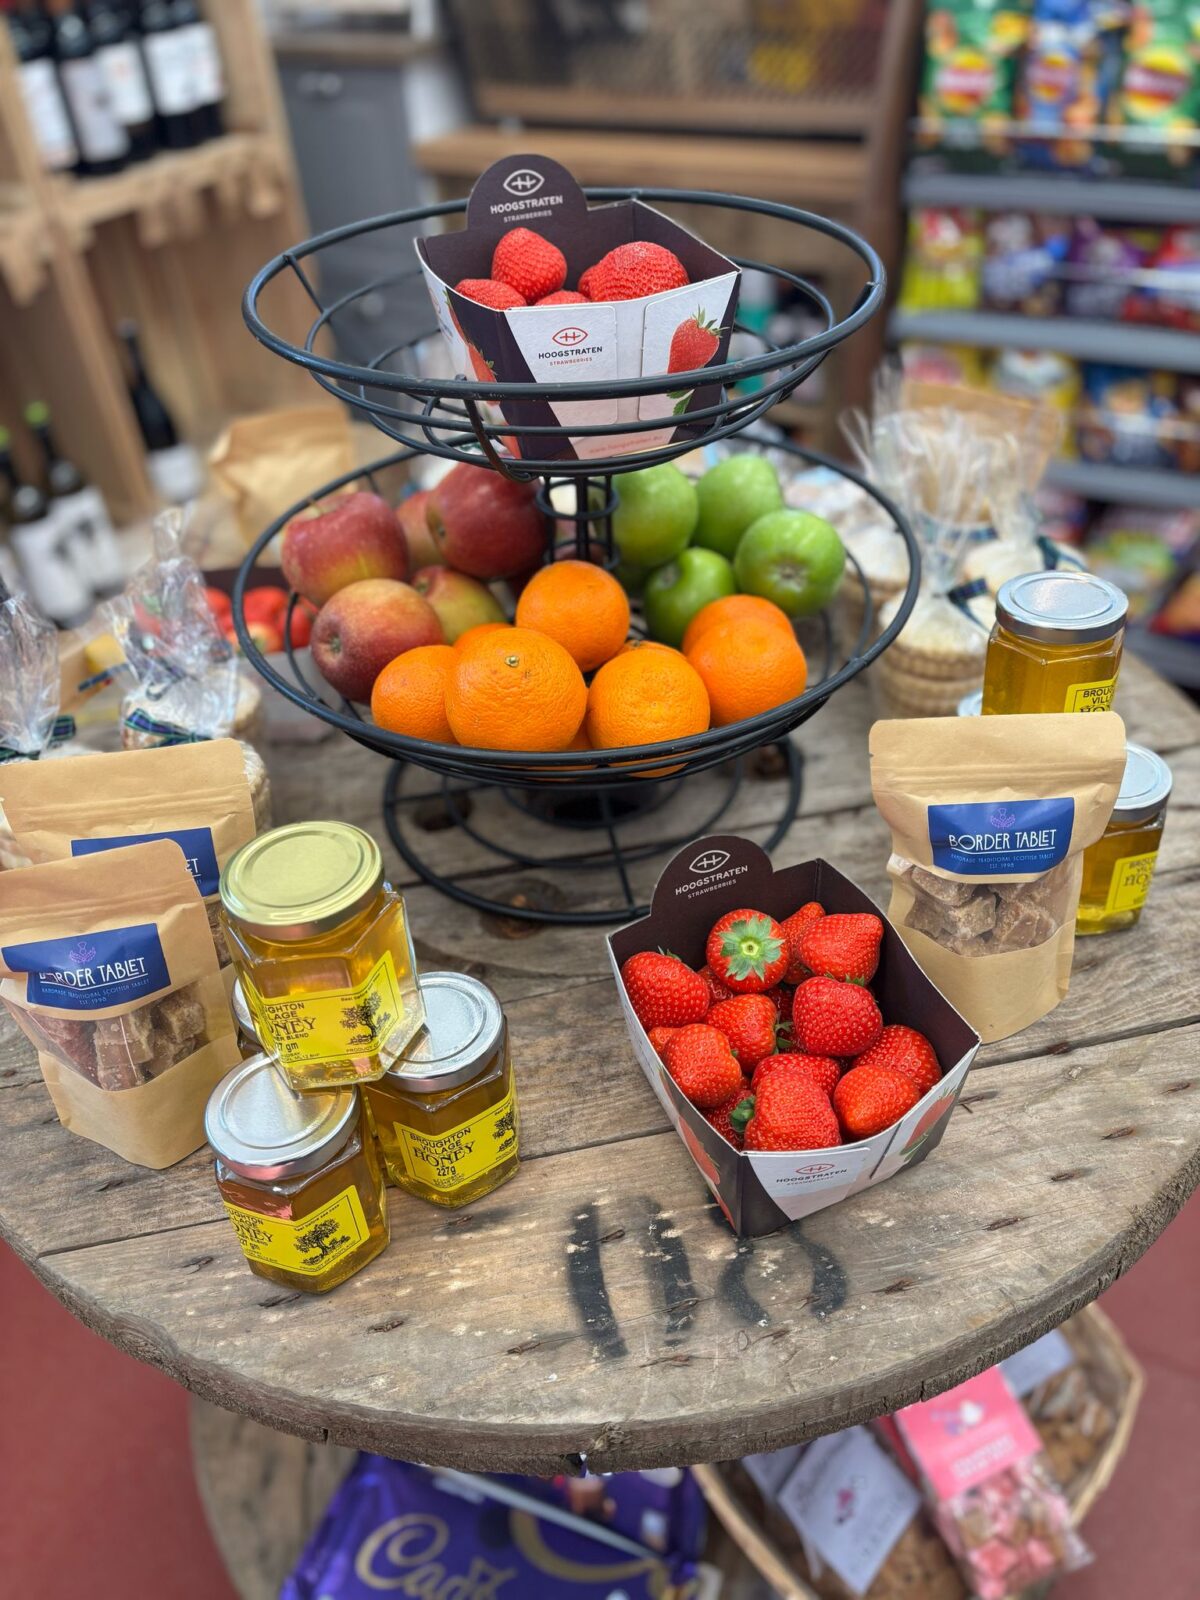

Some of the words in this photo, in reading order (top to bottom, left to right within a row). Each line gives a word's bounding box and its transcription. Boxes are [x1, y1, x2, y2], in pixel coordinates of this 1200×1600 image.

[490, 195, 564, 214] HOOGSTRATEN
[503, 209, 552, 223] STRAWBERRIES
[538, 346, 603, 359] HOOGSTRATEN
[549, 357, 592, 367] STRAWBERRIES
[949, 833, 1010, 851] BORDER
[1015, 829, 1057, 849] TABLET
[675, 865, 748, 895] HOOGSTRATEN
[688, 879, 737, 899] STRAWBERRIES
[97, 957, 148, 982] TABLET
[265, 1003, 305, 1014] GHTON
[286, 1033, 309, 1041] BLEND
[286, 1042, 299, 1053] gm
[410, 1127, 471, 1149] BROUGHTON
[413, 1140, 476, 1168] HONEY
[421, 1140, 461, 1155] VILLAGE
[436, 1166, 457, 1177] 227g
[776, 1168, 848, 1183] HOOGSTRATEN
